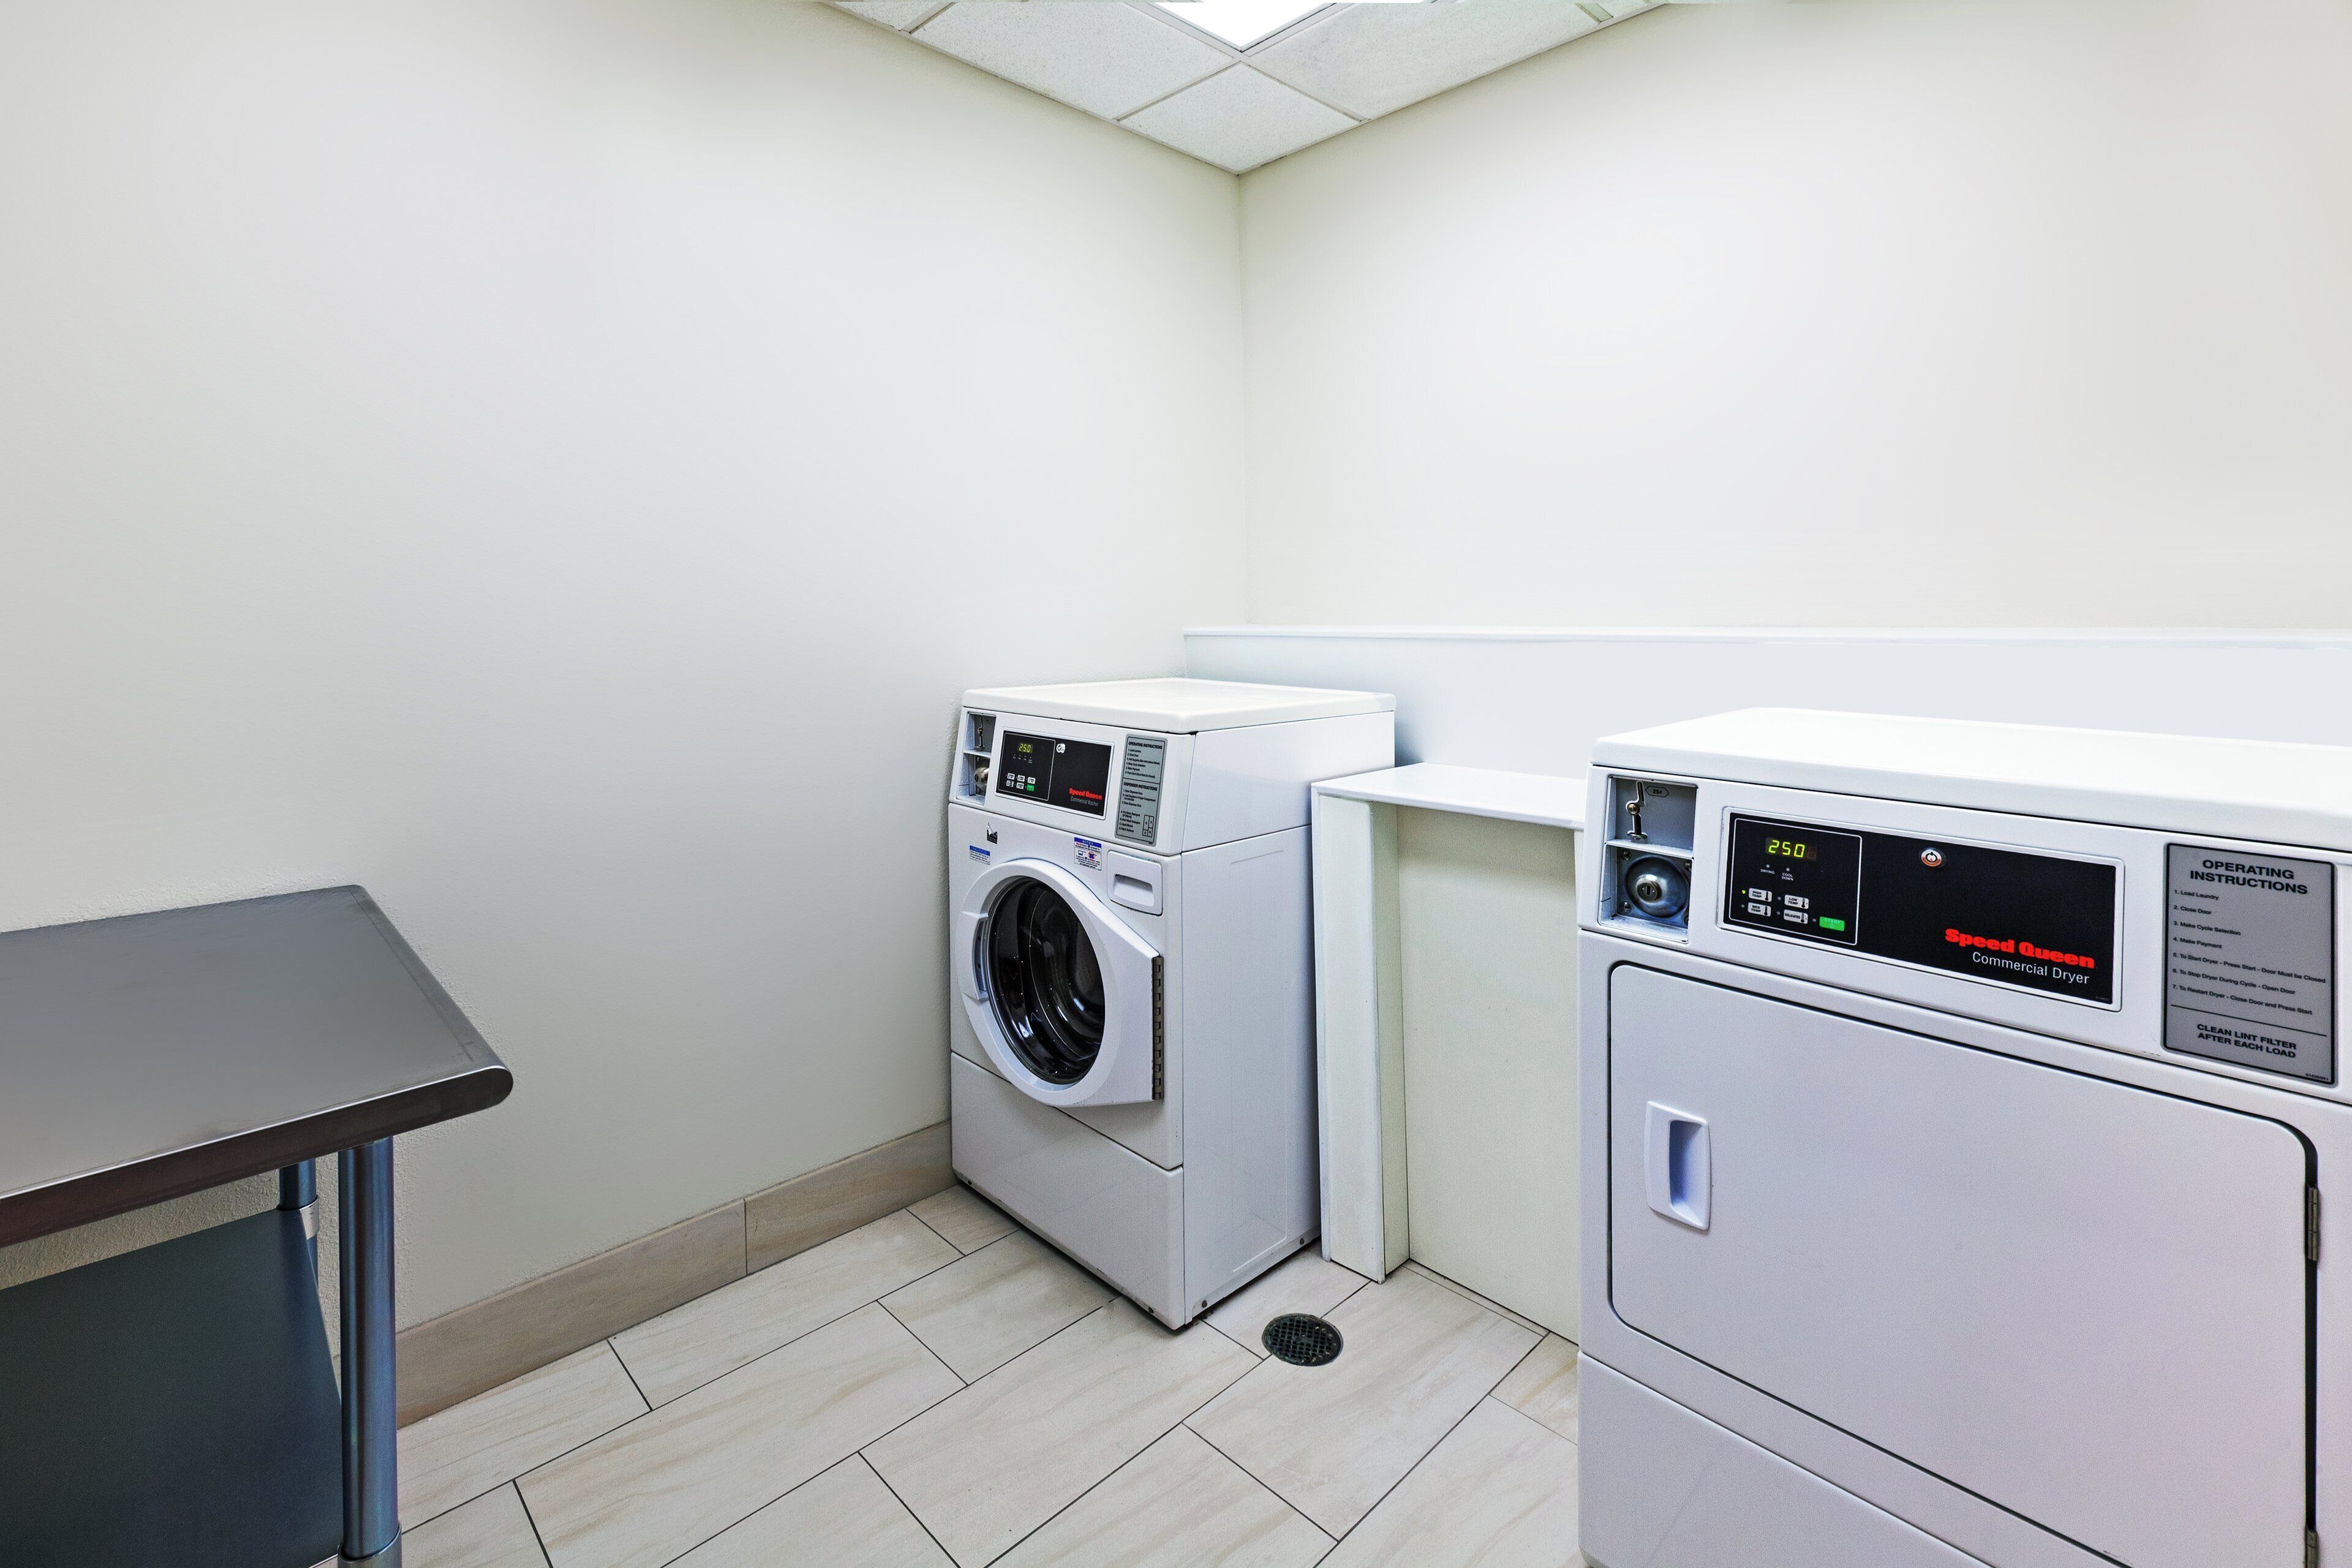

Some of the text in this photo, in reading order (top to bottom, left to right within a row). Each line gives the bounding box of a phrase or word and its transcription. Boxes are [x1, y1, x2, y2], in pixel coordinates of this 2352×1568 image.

[1019, 744, 1031, 753] 250
[1069, 788, 1102, 801] Speed Queen
[1768, 840, 1805, 858] 250
[2203, 860, 2294, 879] OPERATING
[2190, 870, 2308, 894] INSTRUCTIONS
[1945, 929, 2094, 968] Speed Queen
[1972, 952, 2089, 984] Commercial Dryer
[2197, 1023, 2297, 1049] CLEAN LINT FILTER
[2198, 1033, 2296, 1058] AFTER EACH LOAD
